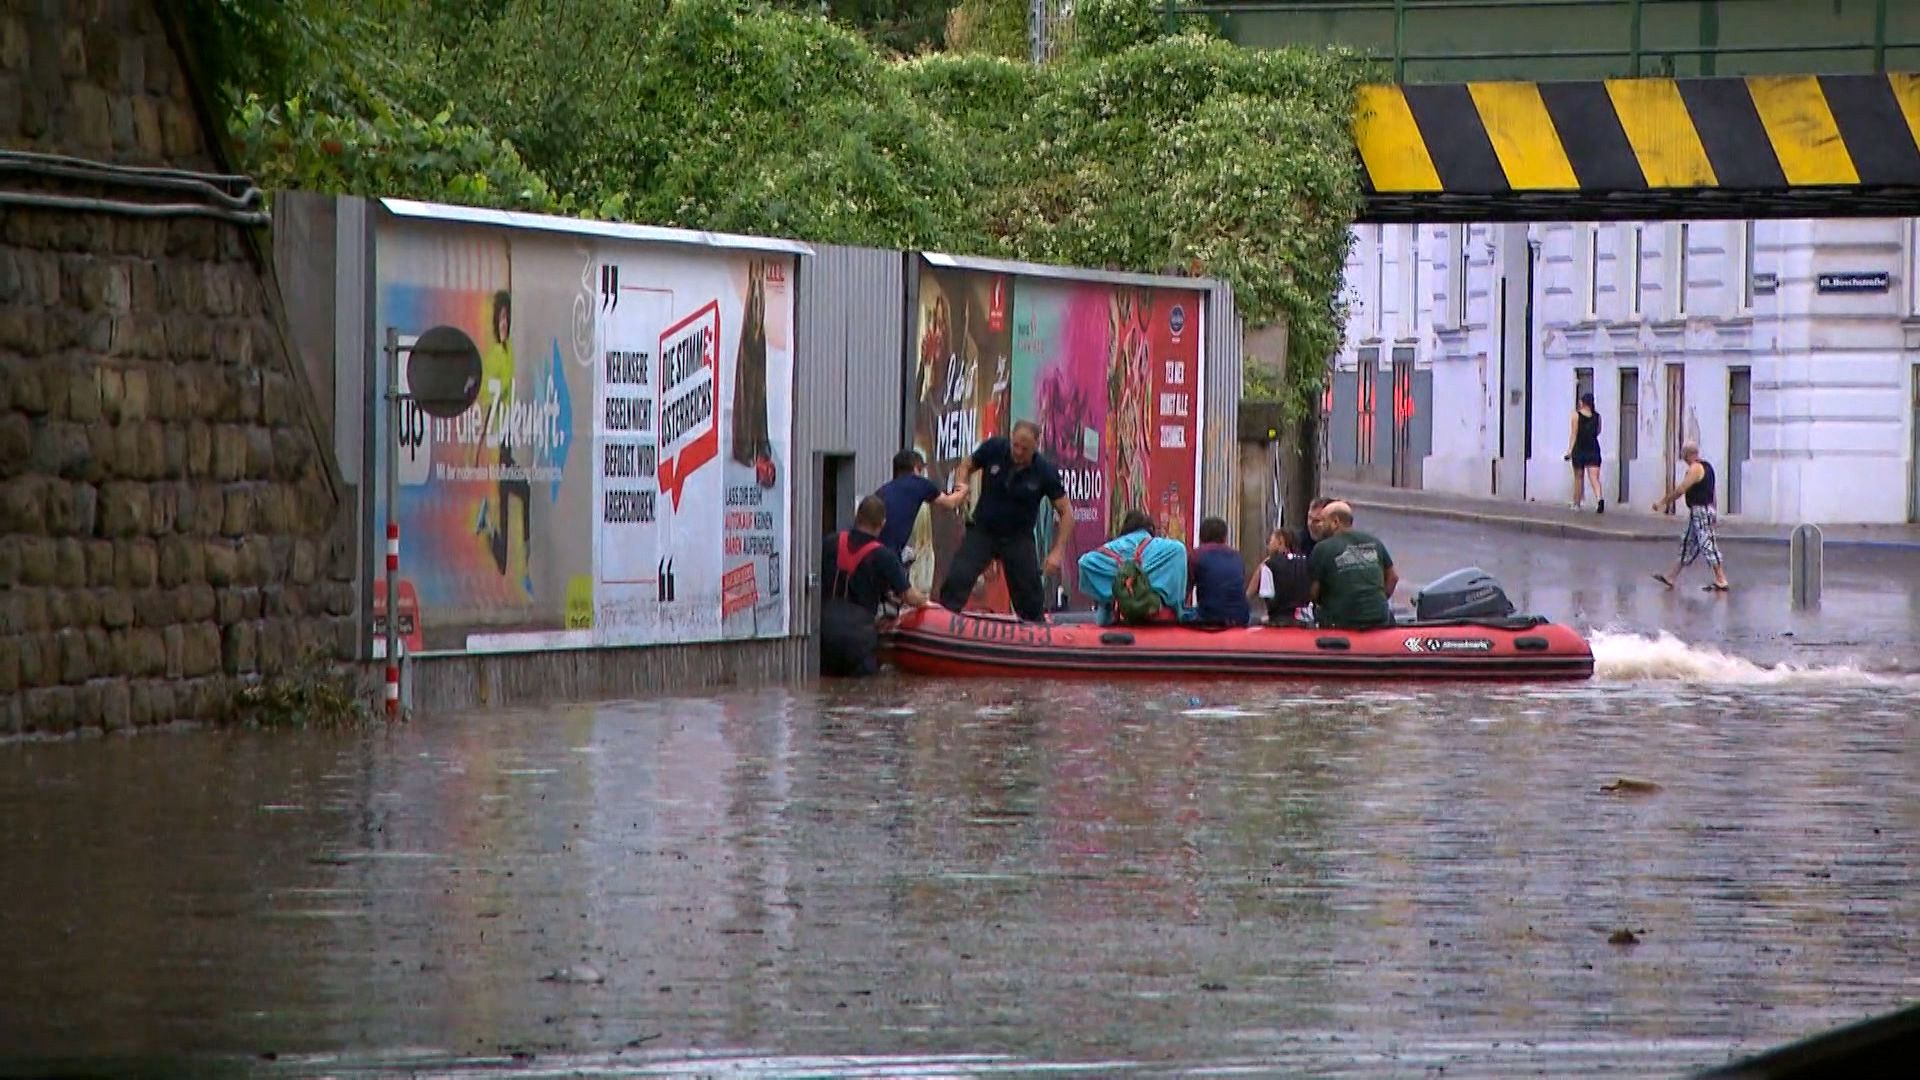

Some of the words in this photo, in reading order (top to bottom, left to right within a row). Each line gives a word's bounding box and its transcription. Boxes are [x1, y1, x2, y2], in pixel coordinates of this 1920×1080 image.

[606, 351, 621, 383] WER
[622, 351, 649, 385] UNSERE
[661, 346, 676, 394] DIE
[676, 325, 713, 384] STIMME
[486, 377, 566, 459] Zukunft.
[605, 397, 631, 430] REGELN
[632, 398, 652, 431] NICHT
[661, 377, 712, 448] ÖSTERREICHS
[637, 444, 656, 478] WIRD
[725, 485, 738, 506] LASS
[739, 486, 748, 505] DIR
[749, 486, 763, 506] BEIM
[753, 511, 774, 530] KEINEN
